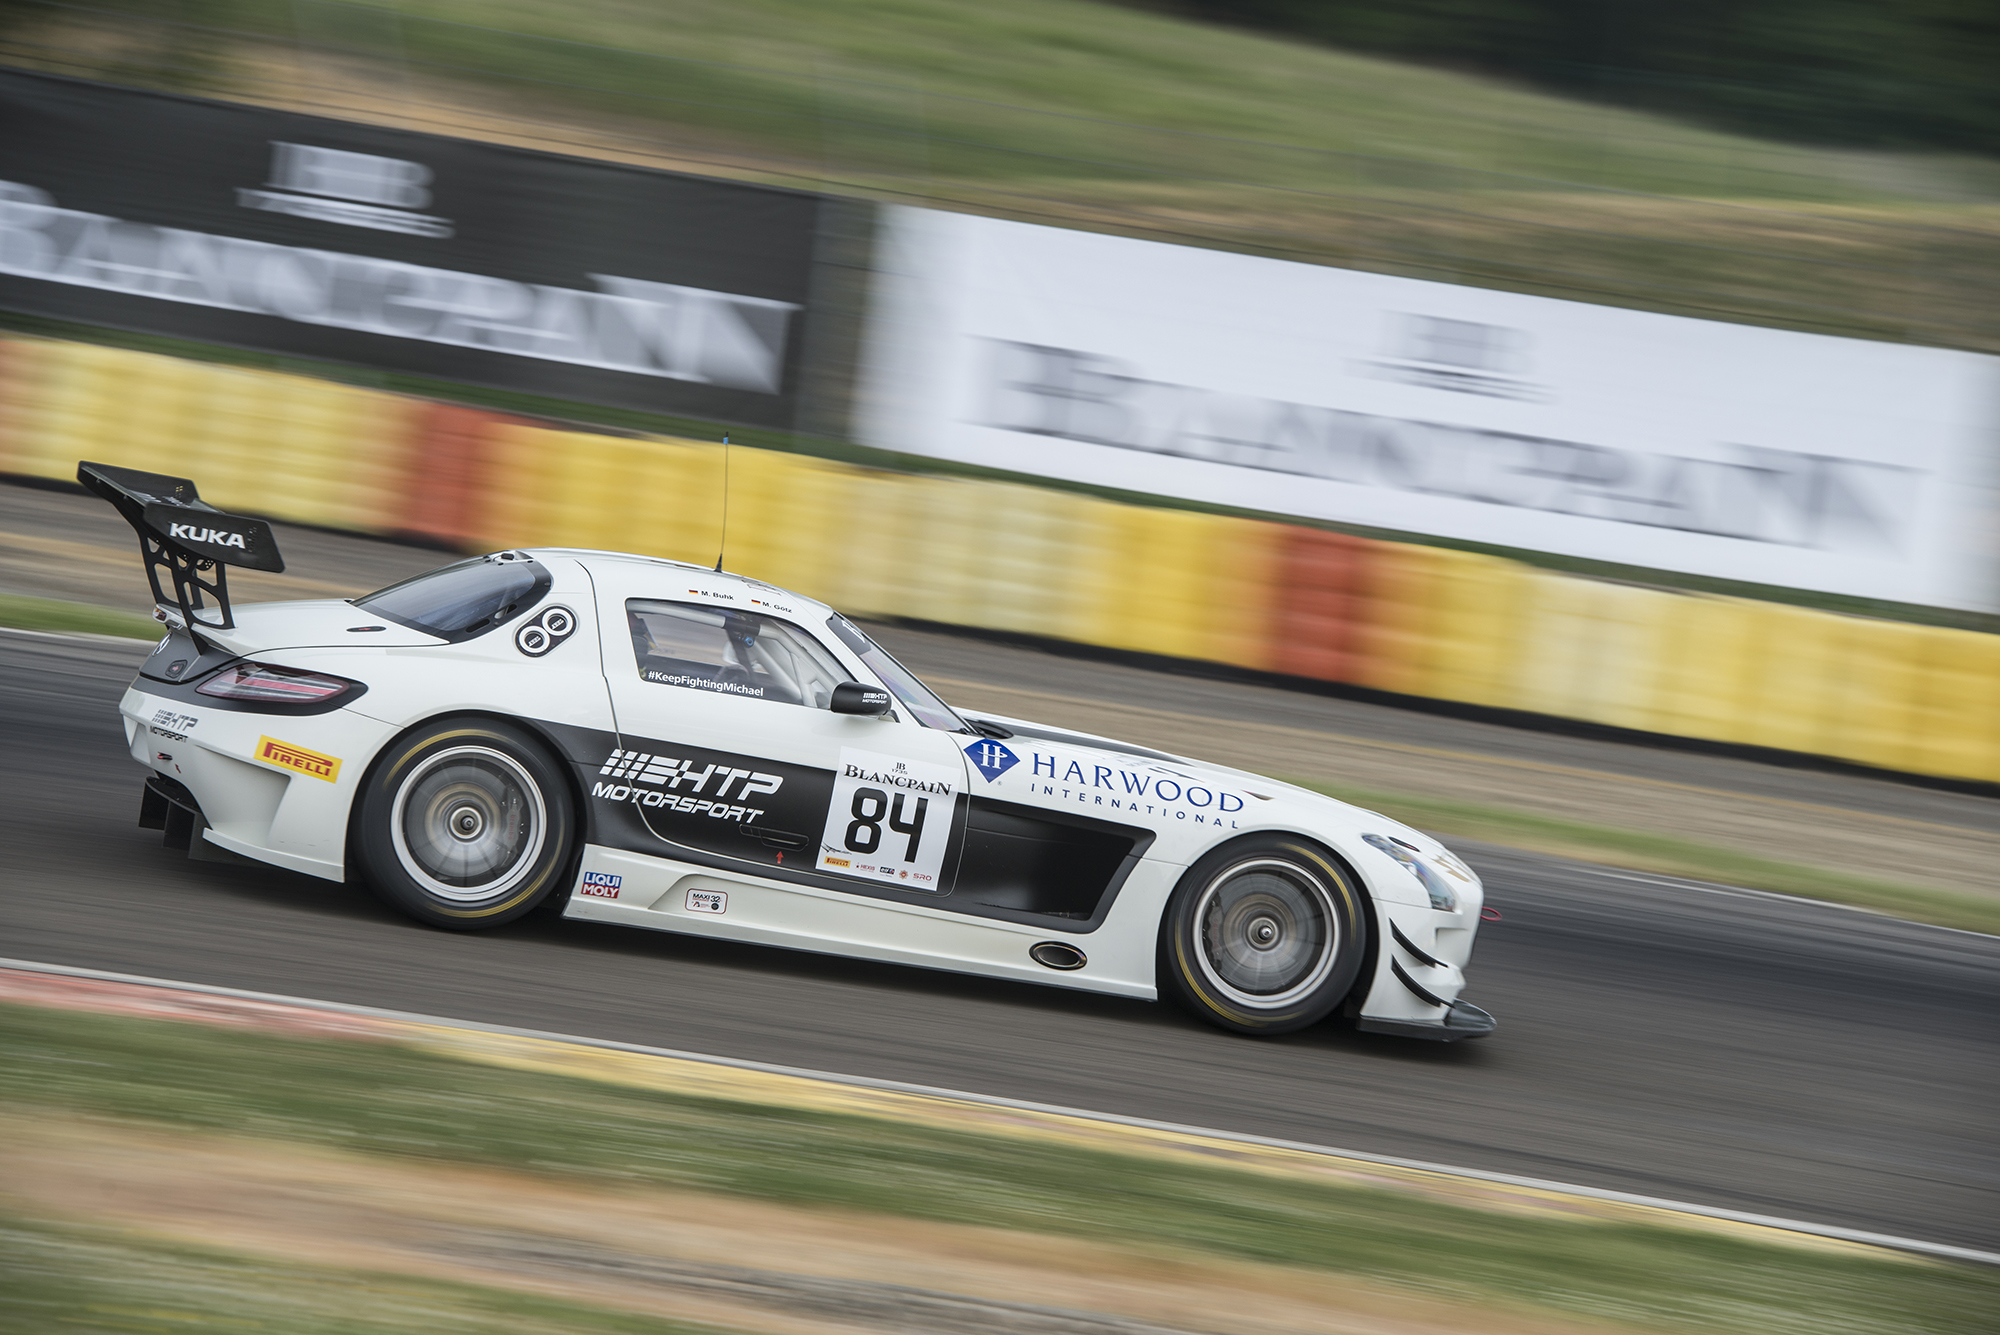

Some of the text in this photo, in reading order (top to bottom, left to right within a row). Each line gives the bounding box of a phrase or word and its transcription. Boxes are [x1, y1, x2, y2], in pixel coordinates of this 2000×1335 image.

[169, 522, 246, 549] KUKA
[712, 591, 734, 601] Buhk
[648, 670, 764, 697] #KeepFightingMichael
[150, 725, 188, 743] MOTORSPORT
[263, 741, 334, 777] PIRELLI
[843, 763, 952, 796] BLANCPAIN
[1031, 752, 1244, 812] HARWOOD
[591, 781, 765, 824] MOTORSPORT
[1031, 783, 1239, 829] INTERNATIONAL
[844, 787, 929, 863] 84
[826, 858, 849, 867] PIRELLI
[585, 873, 620, 887] LIQUI
[913, 873, 932, 881] SRO
[582, 884, 618, 899] MOLY
